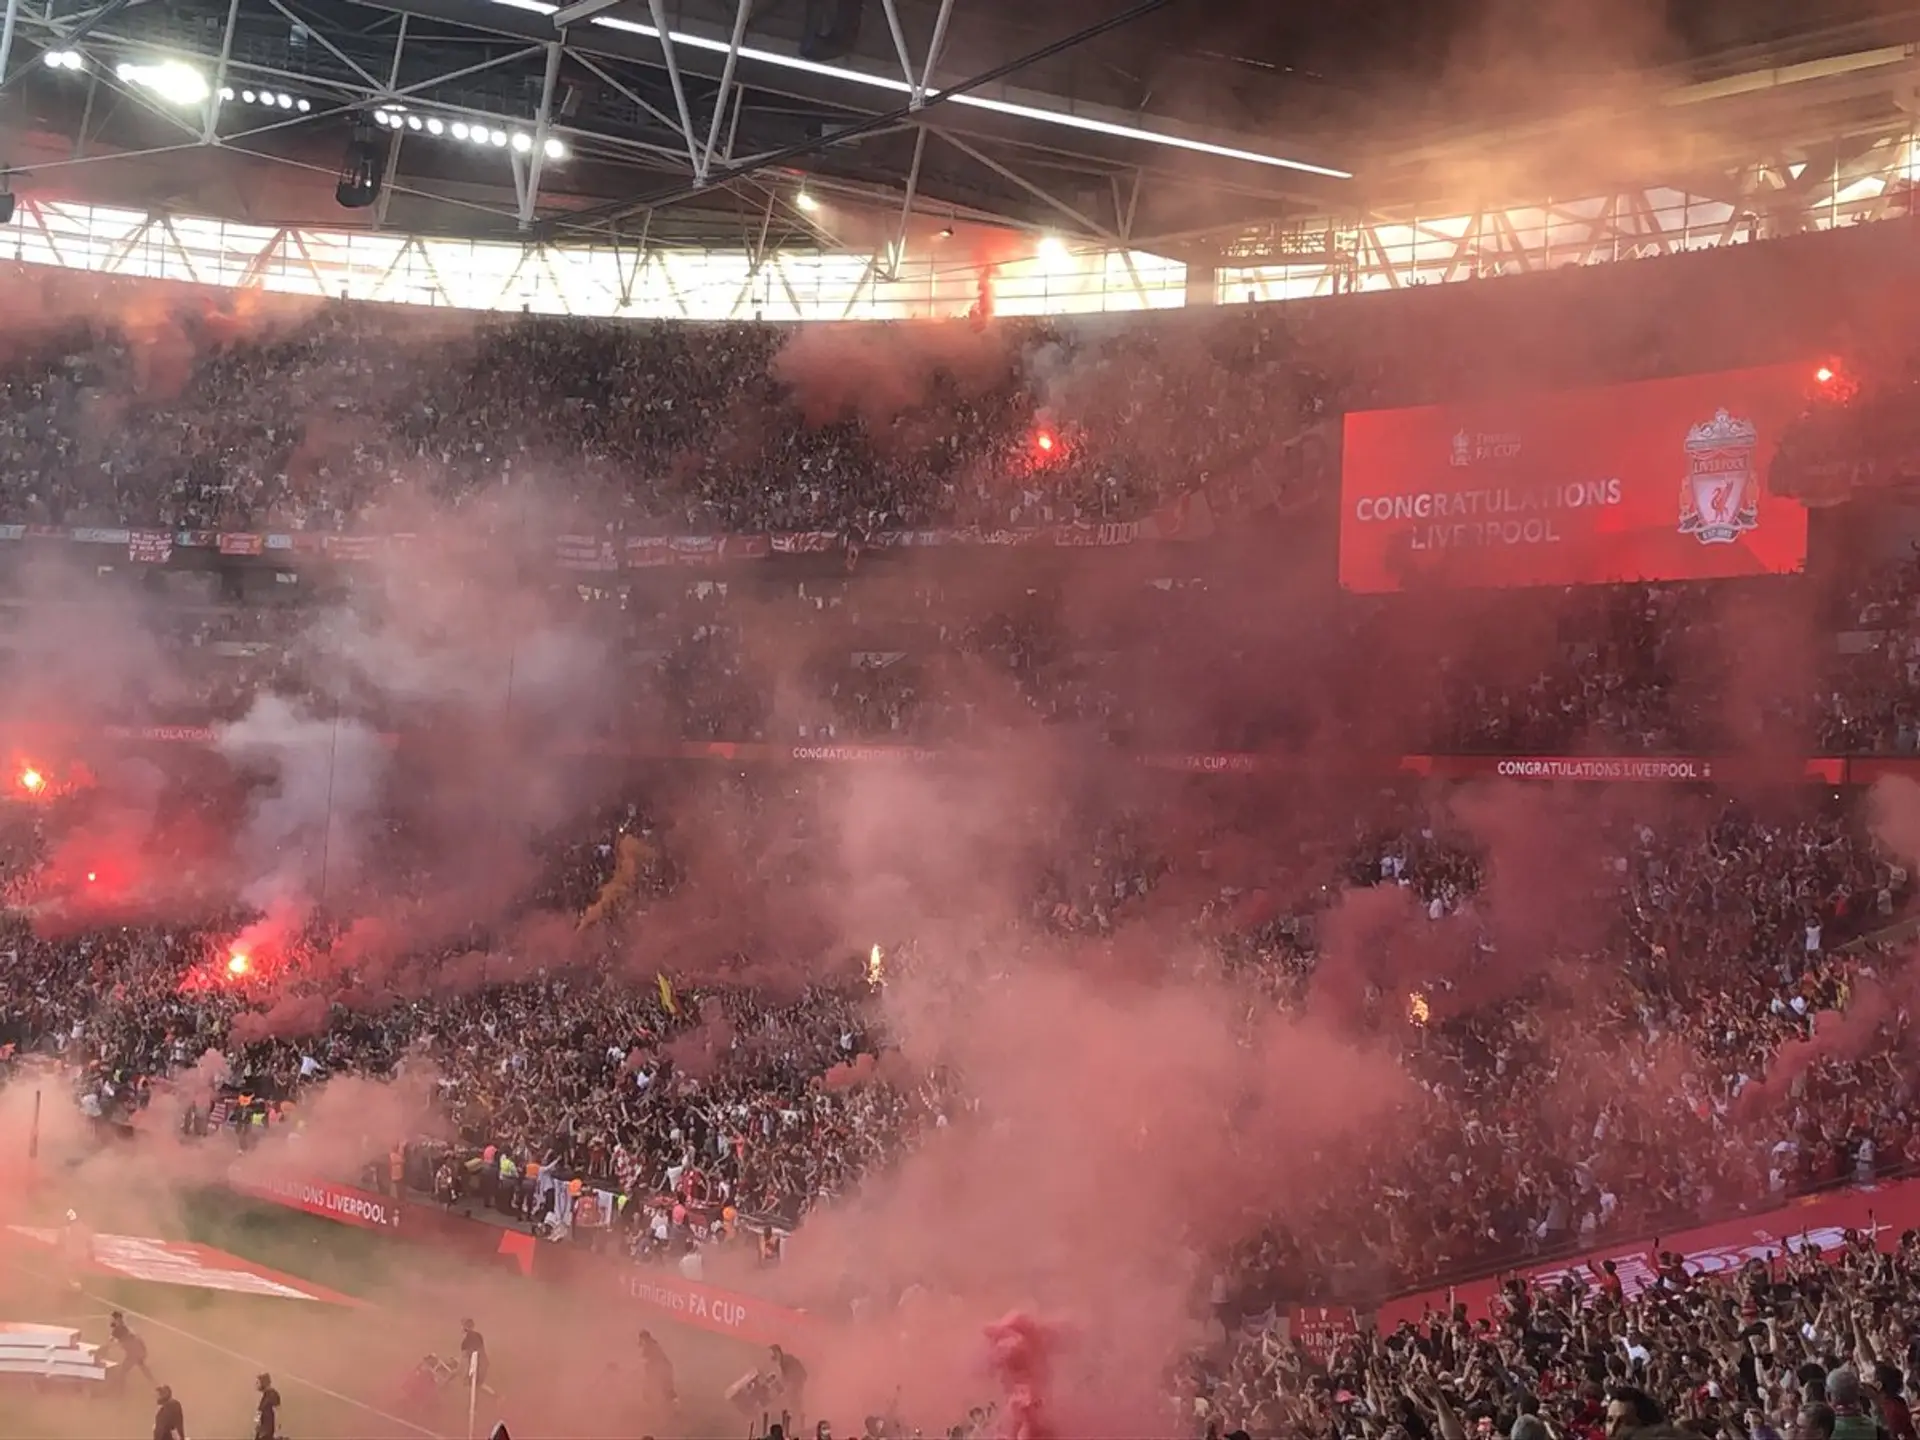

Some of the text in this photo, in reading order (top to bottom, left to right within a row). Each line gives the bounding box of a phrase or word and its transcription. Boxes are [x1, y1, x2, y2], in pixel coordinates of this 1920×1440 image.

[1203, 756, 1228, 770] CUP
[1497, 761, 1697, 778] CONGRATULATIONS LIVERPOOL
[326, 1190, 388, 1225] LIVERPOOL
[629, 1277, 748, 1328] Emirates FA CUP
